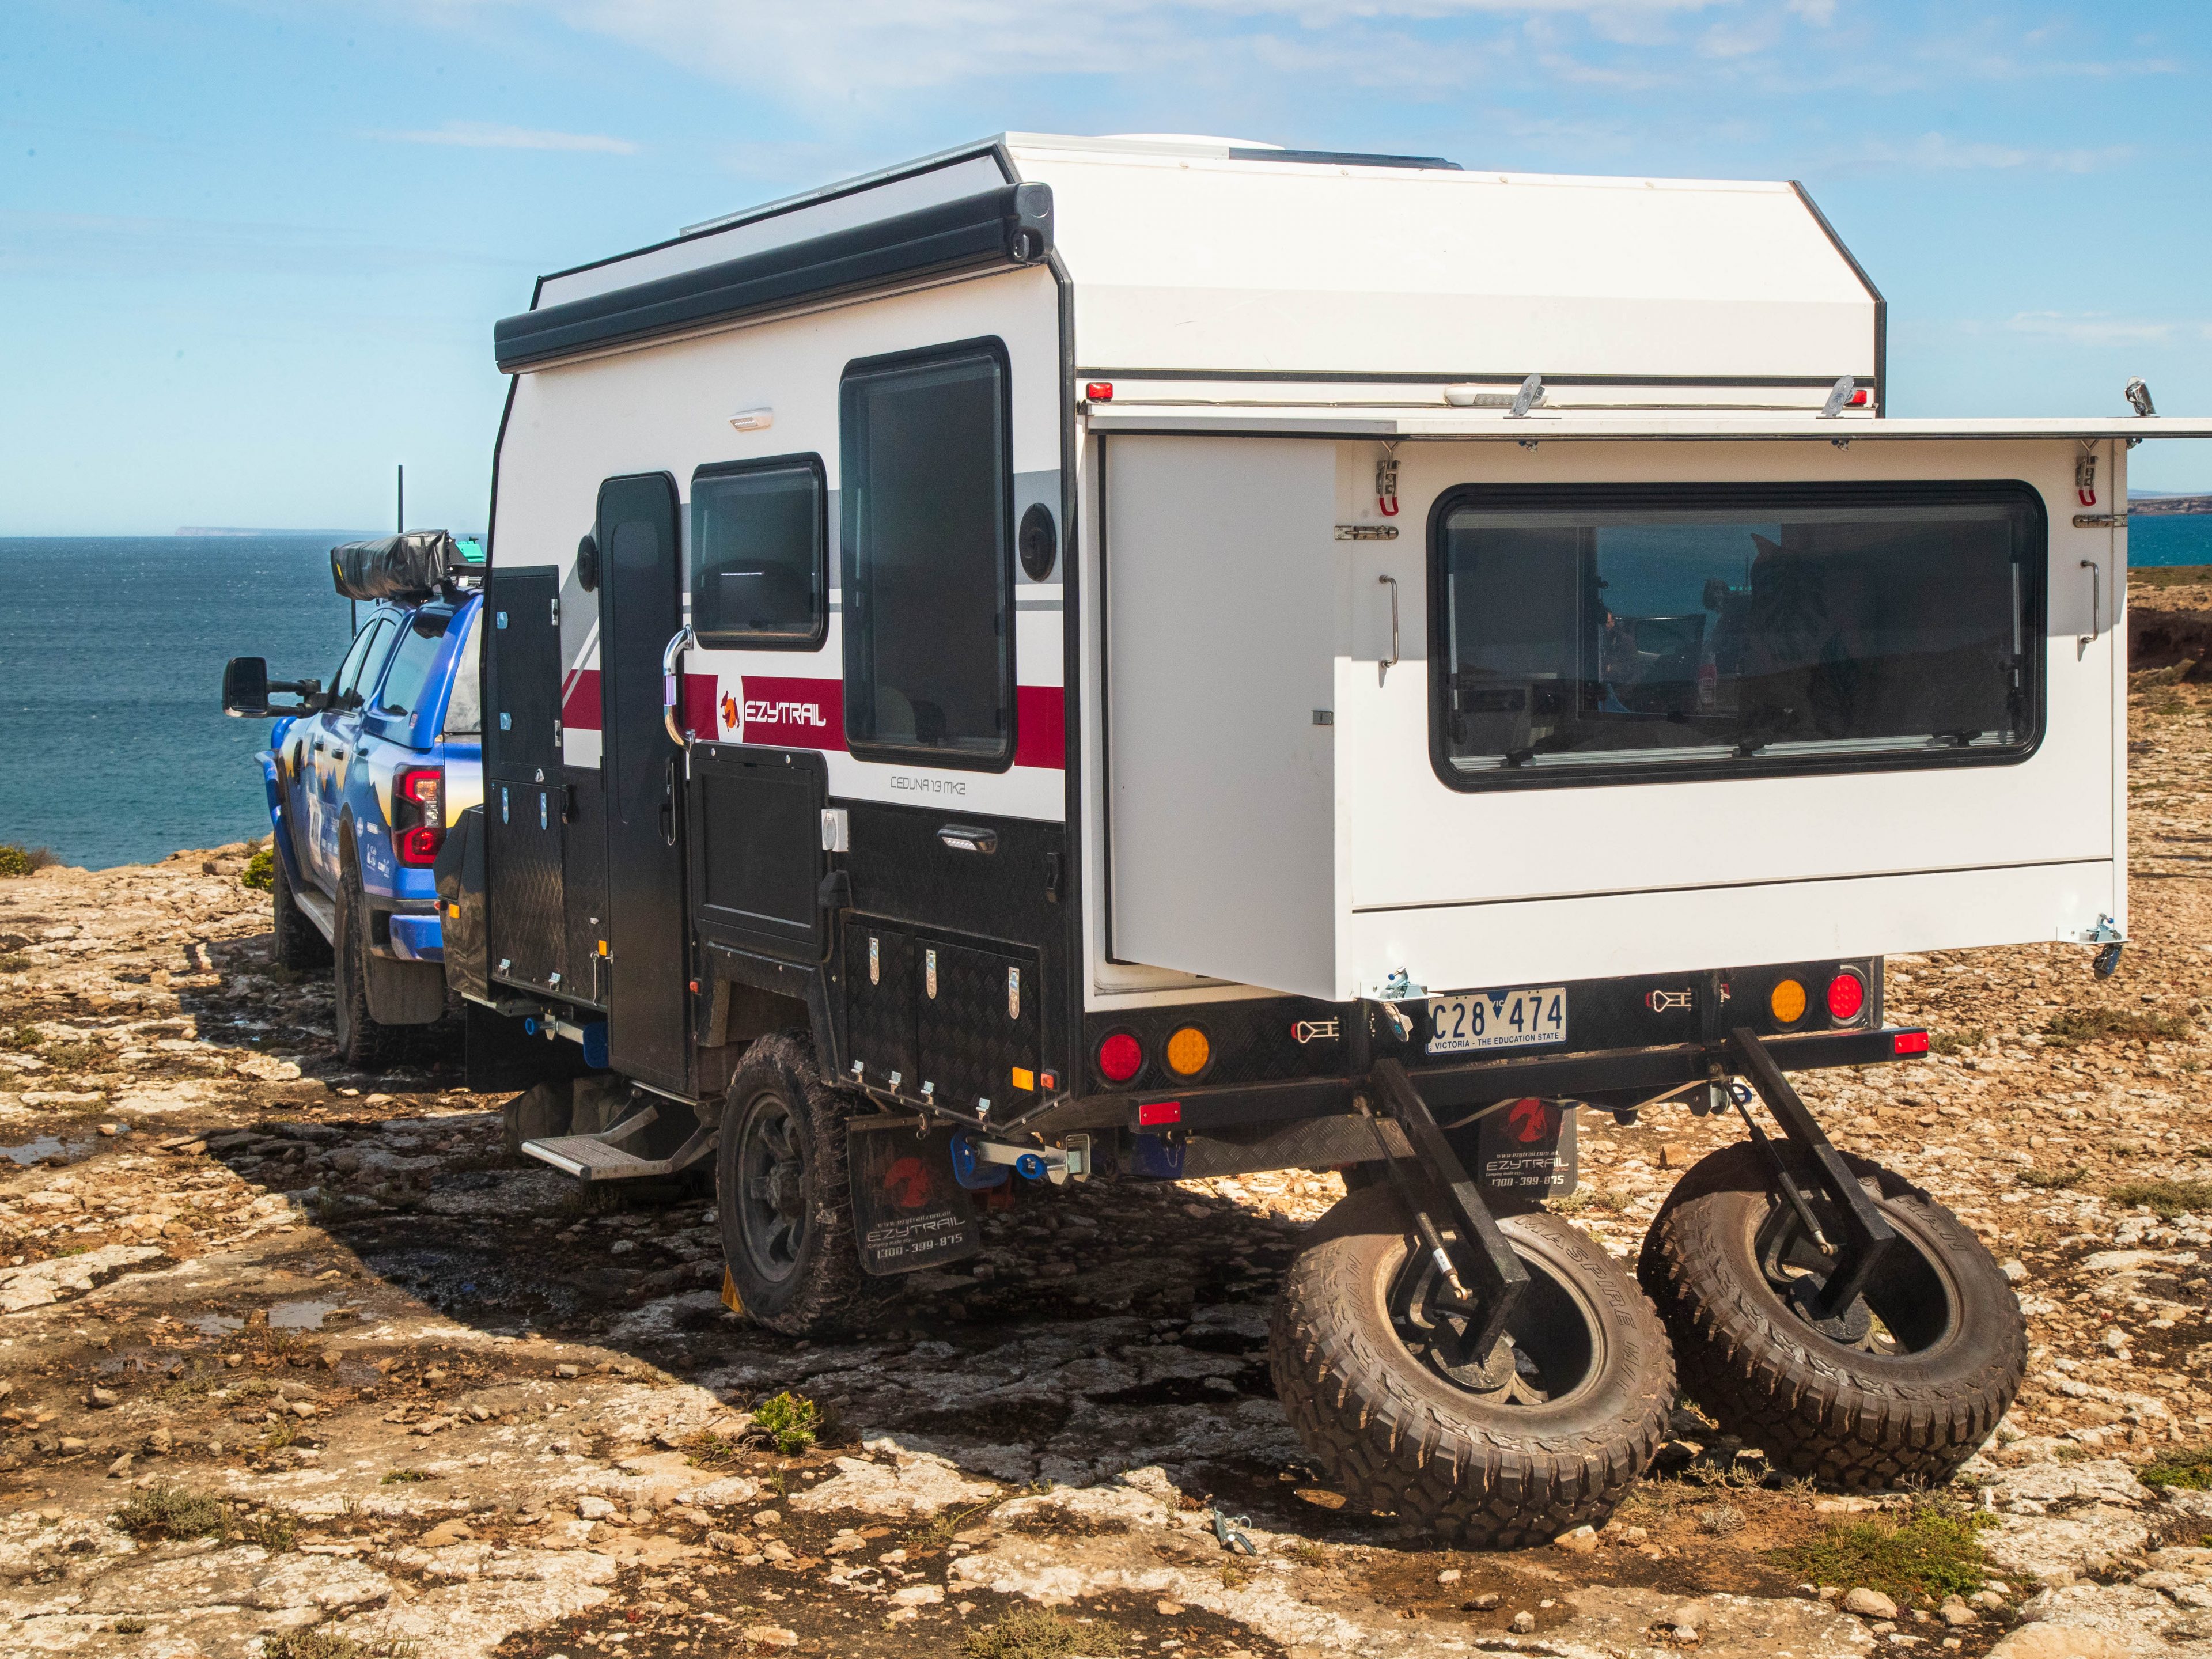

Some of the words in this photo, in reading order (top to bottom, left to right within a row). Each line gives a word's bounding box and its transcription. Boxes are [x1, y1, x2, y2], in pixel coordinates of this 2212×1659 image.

[745, 700, 827, 726] EZYTRAIL
[891, 776, 929, 792] CEDUNA
[931, 780, 941, 792] 13
[944, 781, 966, 796] MK2
[1491, 999, 1505, 1008] VIC
[1433, 1002, 1485, 1040] C28
[1509, 995, 1562, 1033] 474
[1435, 1040, 1469, 1050] VICTORIA
[1478, 1037, 1491, 1046] THE
[1494, 1034, 1536, 1044] EDUCATION
[1538, 1032, 1559, 1041] STATE
[1486, 1157, 1569, 1171] EZYTRAIL
[868, 1217, 965, 1242] EZYTRAIL
[1514, 1215, 1637, 1330] MASPIRE
